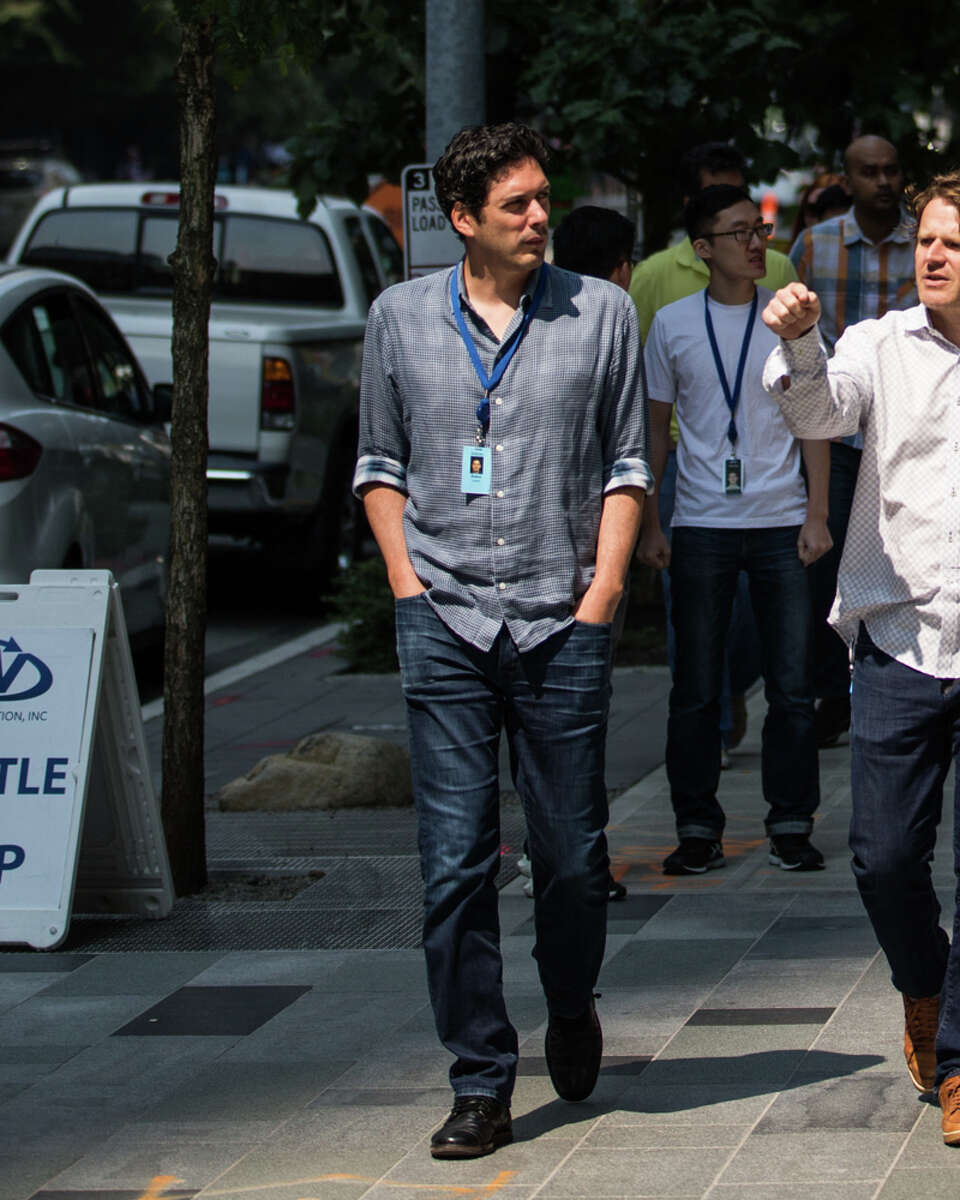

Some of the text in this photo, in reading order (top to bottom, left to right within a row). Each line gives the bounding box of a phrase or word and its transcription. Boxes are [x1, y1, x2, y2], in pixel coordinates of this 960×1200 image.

[412, 171, 426, 189] 3
[411, 214, 447, 232] LOAD
[28, 711, 48, 721] INC
[0, 757, 69, 795] TLE
